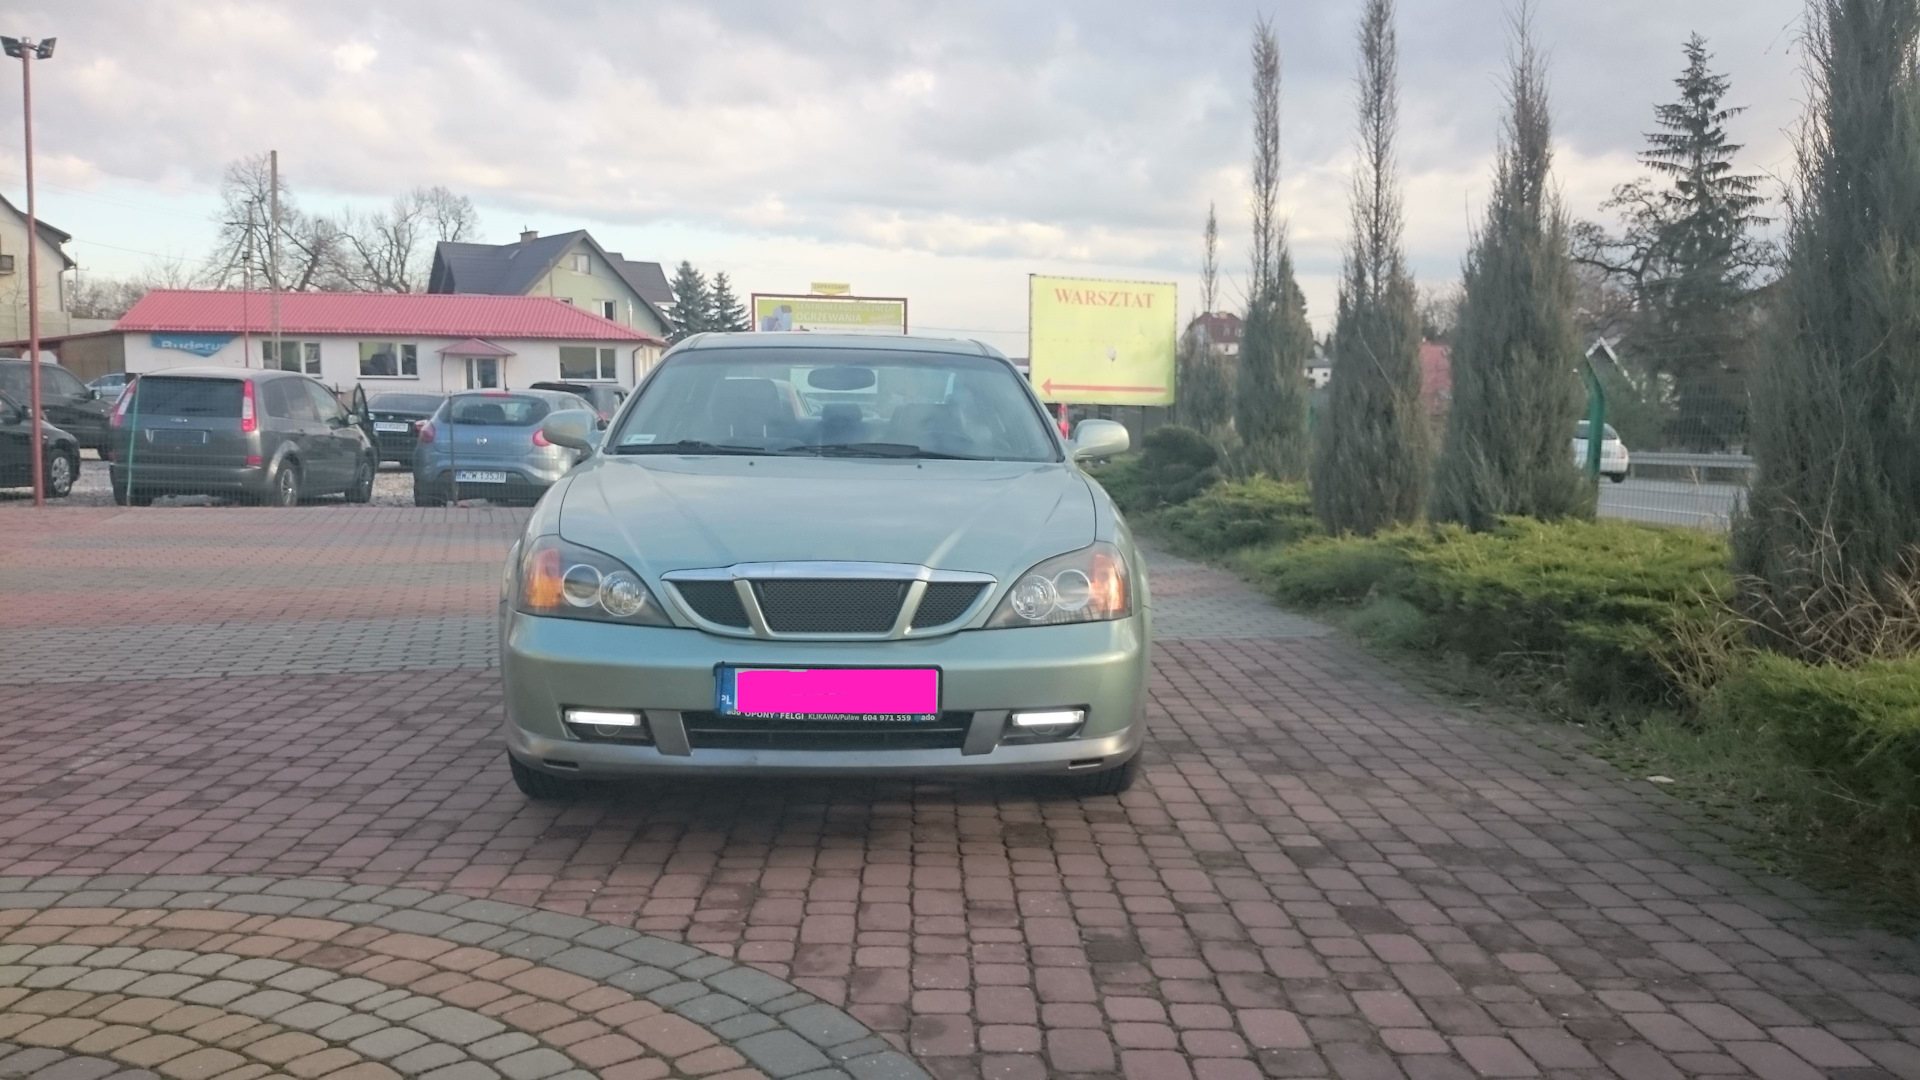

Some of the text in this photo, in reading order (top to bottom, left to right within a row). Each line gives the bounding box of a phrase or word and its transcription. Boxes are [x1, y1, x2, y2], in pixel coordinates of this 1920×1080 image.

[1054, 288, 1155, 309] WARSZTAT
[796, 302, 896, 313] CENTRUM EKOLOGICZNEGO
[796, 312, 862, 323] OGRZEWANIA
